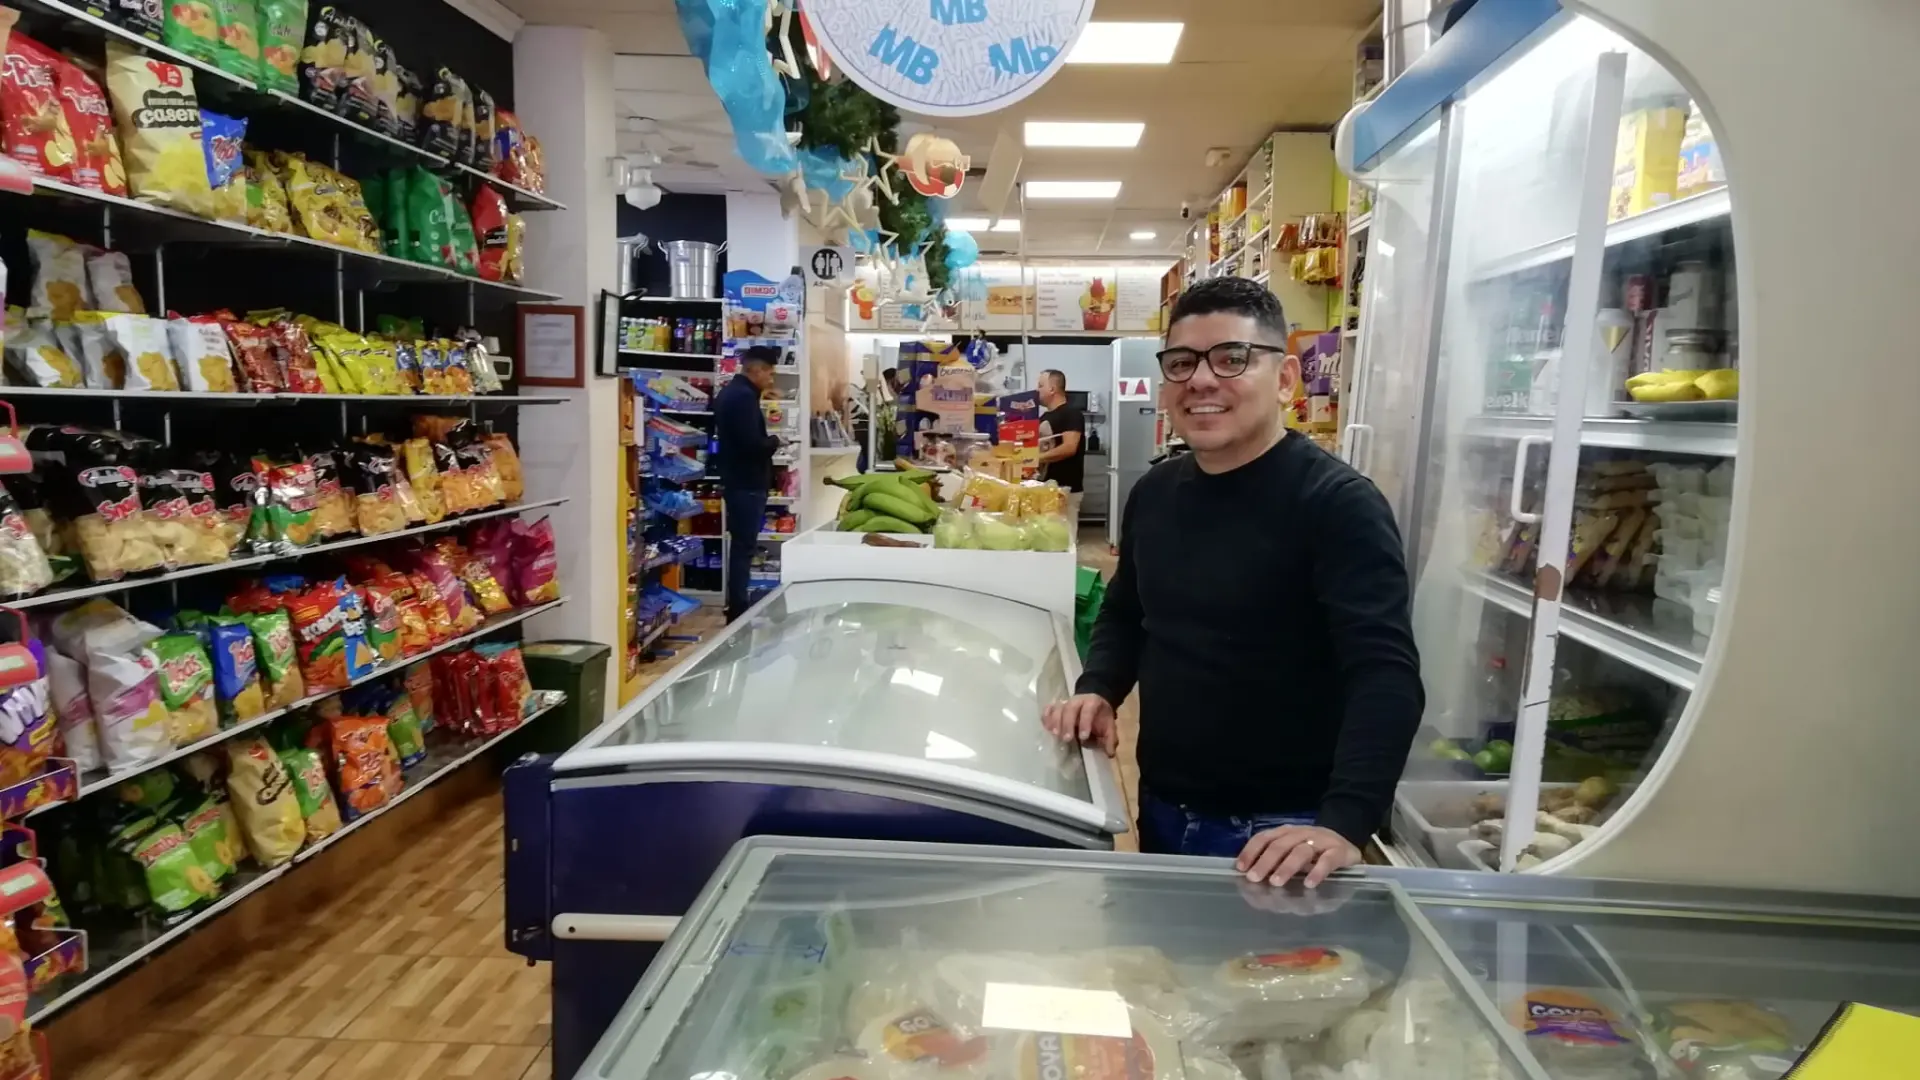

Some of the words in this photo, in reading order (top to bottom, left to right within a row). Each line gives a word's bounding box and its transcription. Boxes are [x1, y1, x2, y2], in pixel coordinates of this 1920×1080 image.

[930, 0, 988, 25] MB
[868, 22, 940, 86] MB
[744, 287, 776, 295] BIMBO
